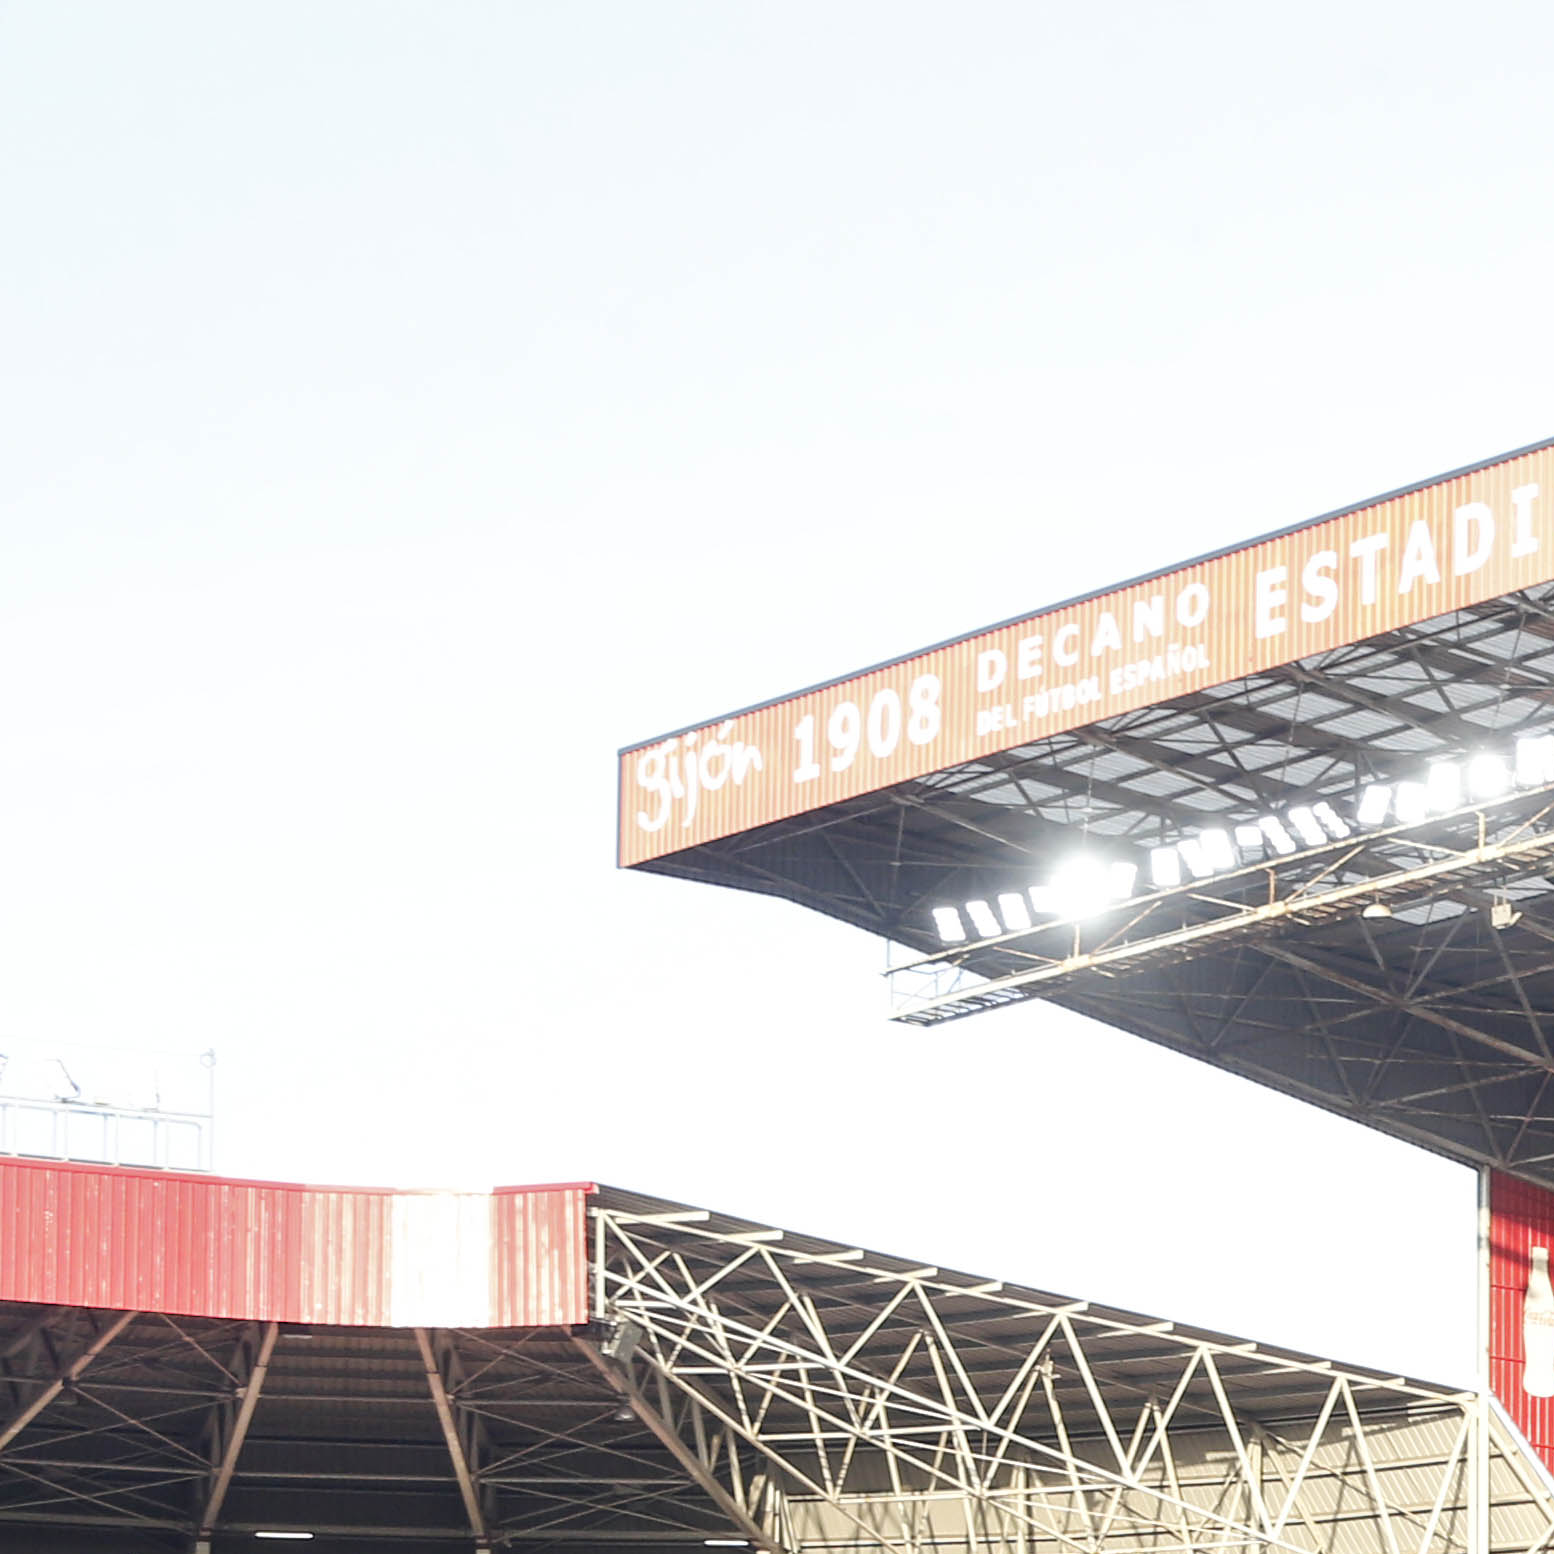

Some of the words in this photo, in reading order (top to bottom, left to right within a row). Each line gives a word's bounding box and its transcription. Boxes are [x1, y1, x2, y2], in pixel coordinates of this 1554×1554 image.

[976, 581, 1211, 694] DECANO
[976, 705, 1017, 738] DEL
[1108, 642, 1210, 696] ESPAÑOL
[790, 672, 941, 784] 1908
